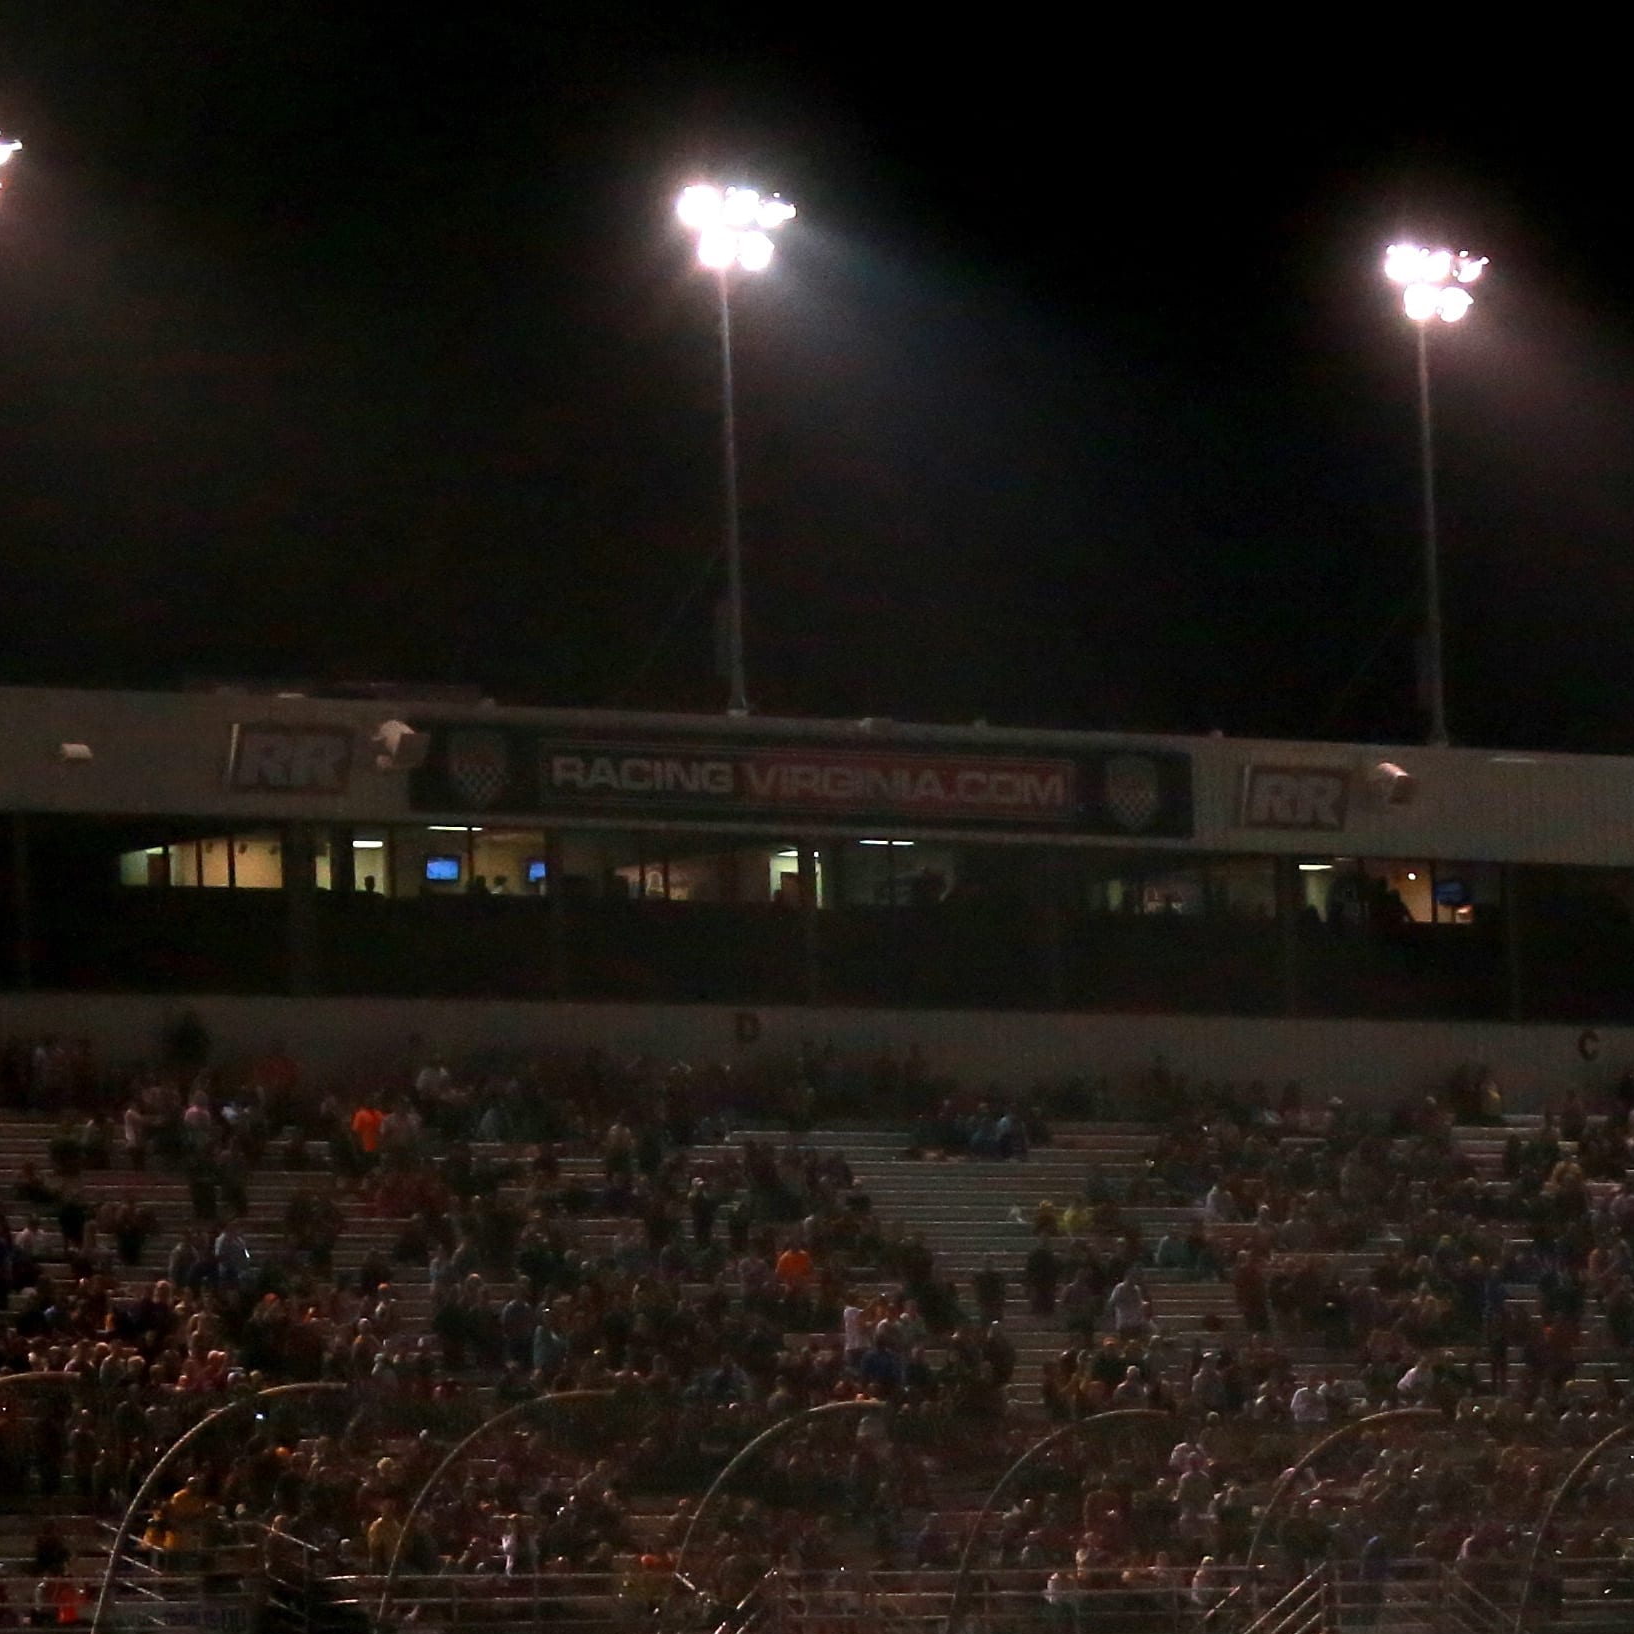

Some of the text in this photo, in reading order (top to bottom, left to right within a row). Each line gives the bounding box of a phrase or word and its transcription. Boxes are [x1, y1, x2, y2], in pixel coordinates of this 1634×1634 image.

[551, 755, 1065, 806] RACING VIRGINIA.COM
[1578, 1030, 1600, 1062] C
